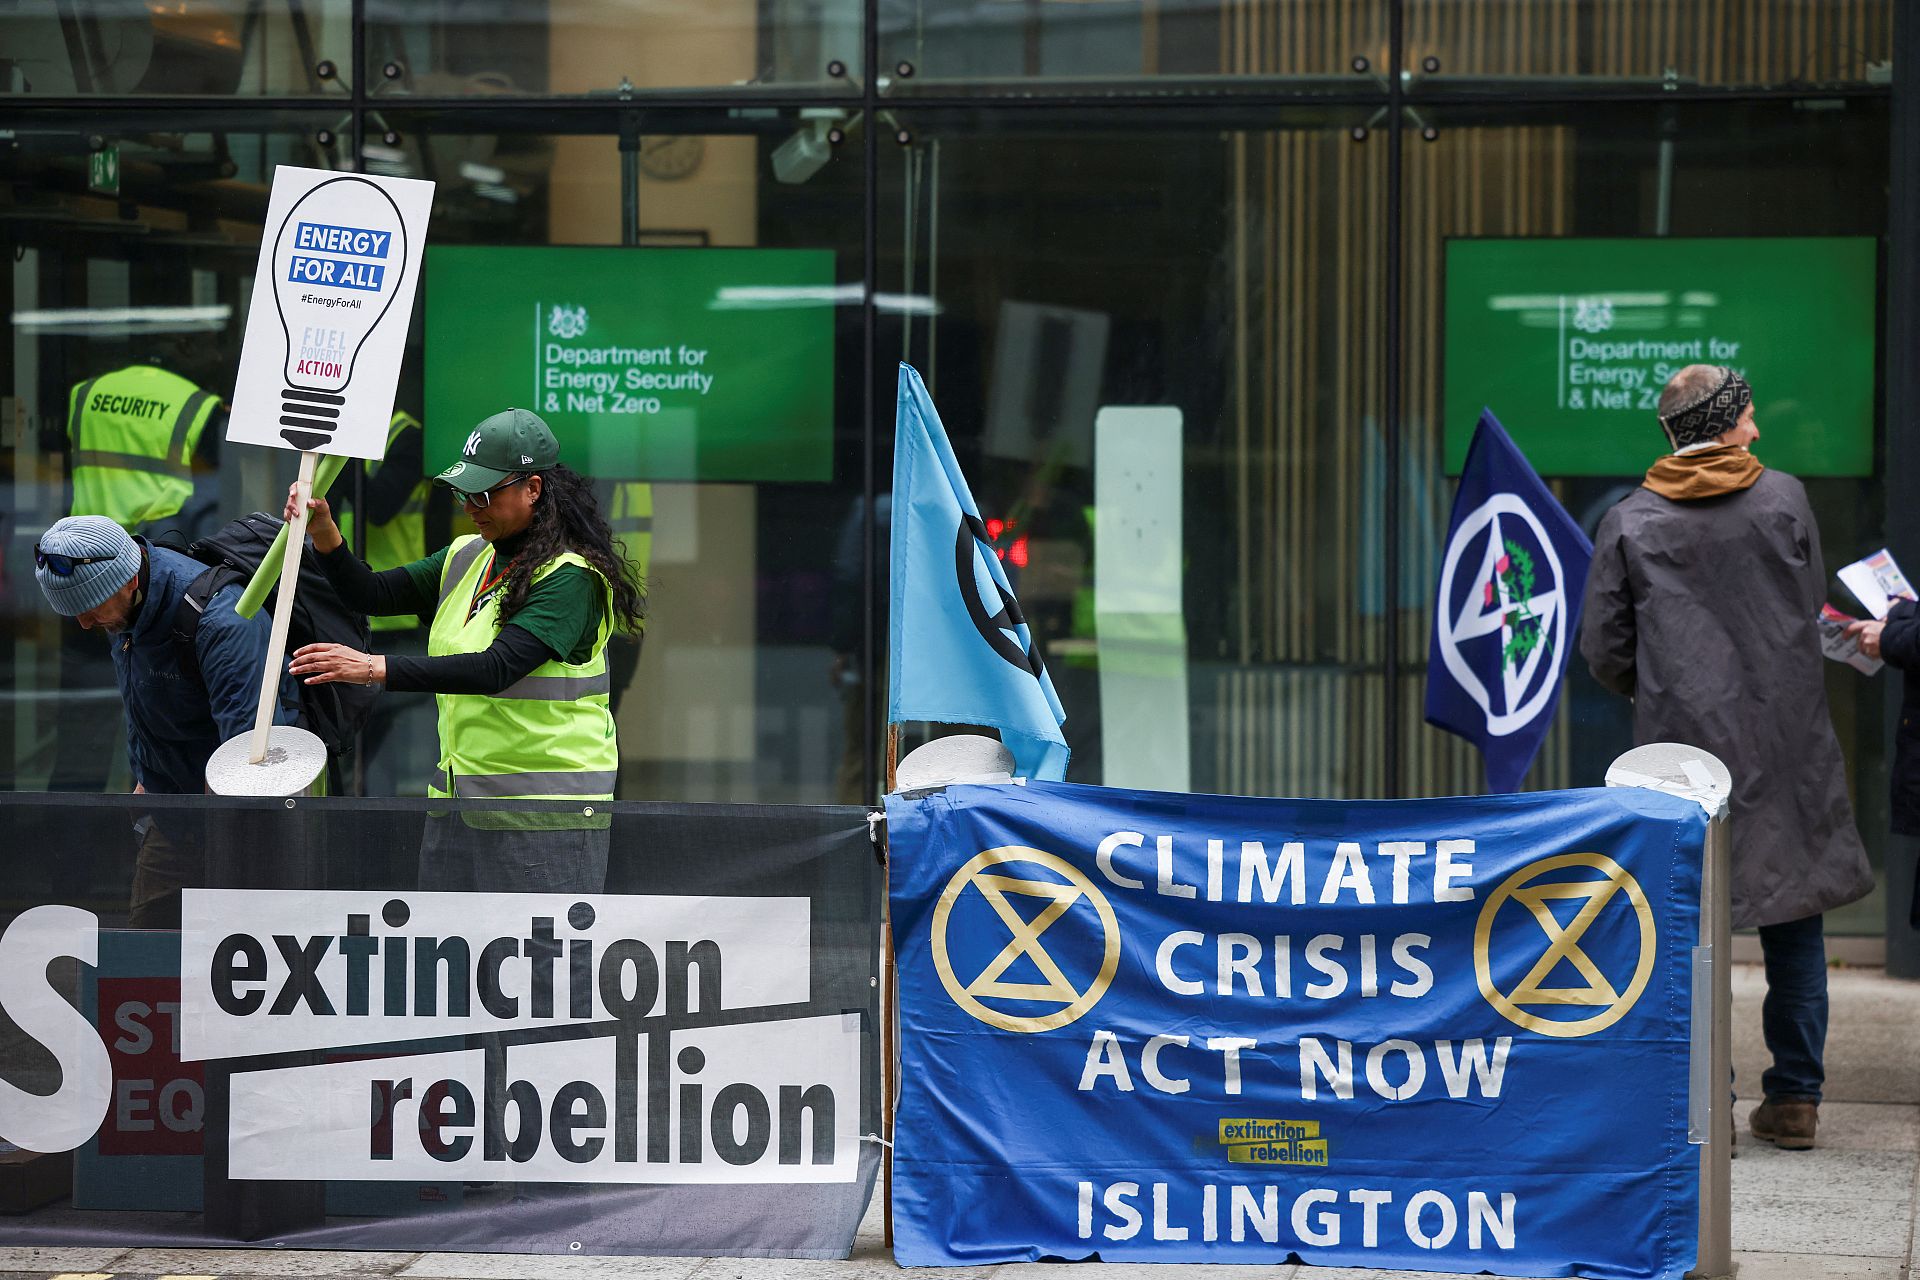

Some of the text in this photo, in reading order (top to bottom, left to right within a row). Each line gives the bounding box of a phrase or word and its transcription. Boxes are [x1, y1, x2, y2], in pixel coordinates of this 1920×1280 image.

[299, 226, 387, 255] ENERGY
[292, 258, 379, 288] FOR ALL
[301, 294, 362, 309] #EnergyForAll
[302, 326, 346, 350] FUEL
[1569, 337, 1740, 363] Department for
[300, 346, 345, 364] POVERTY
[545, 344, 708, 368] Department for
[297, 360, 342, 379] ACTION
[545, 368, 714, 395] Energy Security
[1569, 362, 1647, 390] Energy
[91, 393, 170, 420] SECURITY
[545, 392, 661, 414] & Net Zero
[1568, 387, 1586, 410] &
[1591, 388, 1631, 410] Net
[1096, 831, 1477, 905] CLIMATE
[210, 898, 722, 1020] extinction
[1155, 931, 1434, 999] CRISIS
[1078, 1030, 1513, 1101] ACT NOW
[370, 1033, 836, 1166] rebellion
[1224, 1120, 1306, 1139] extinction
[1250, 1140, 1324, 1162] rebellion
[1078, 1181, 1517, 1249] ISLINGTON
